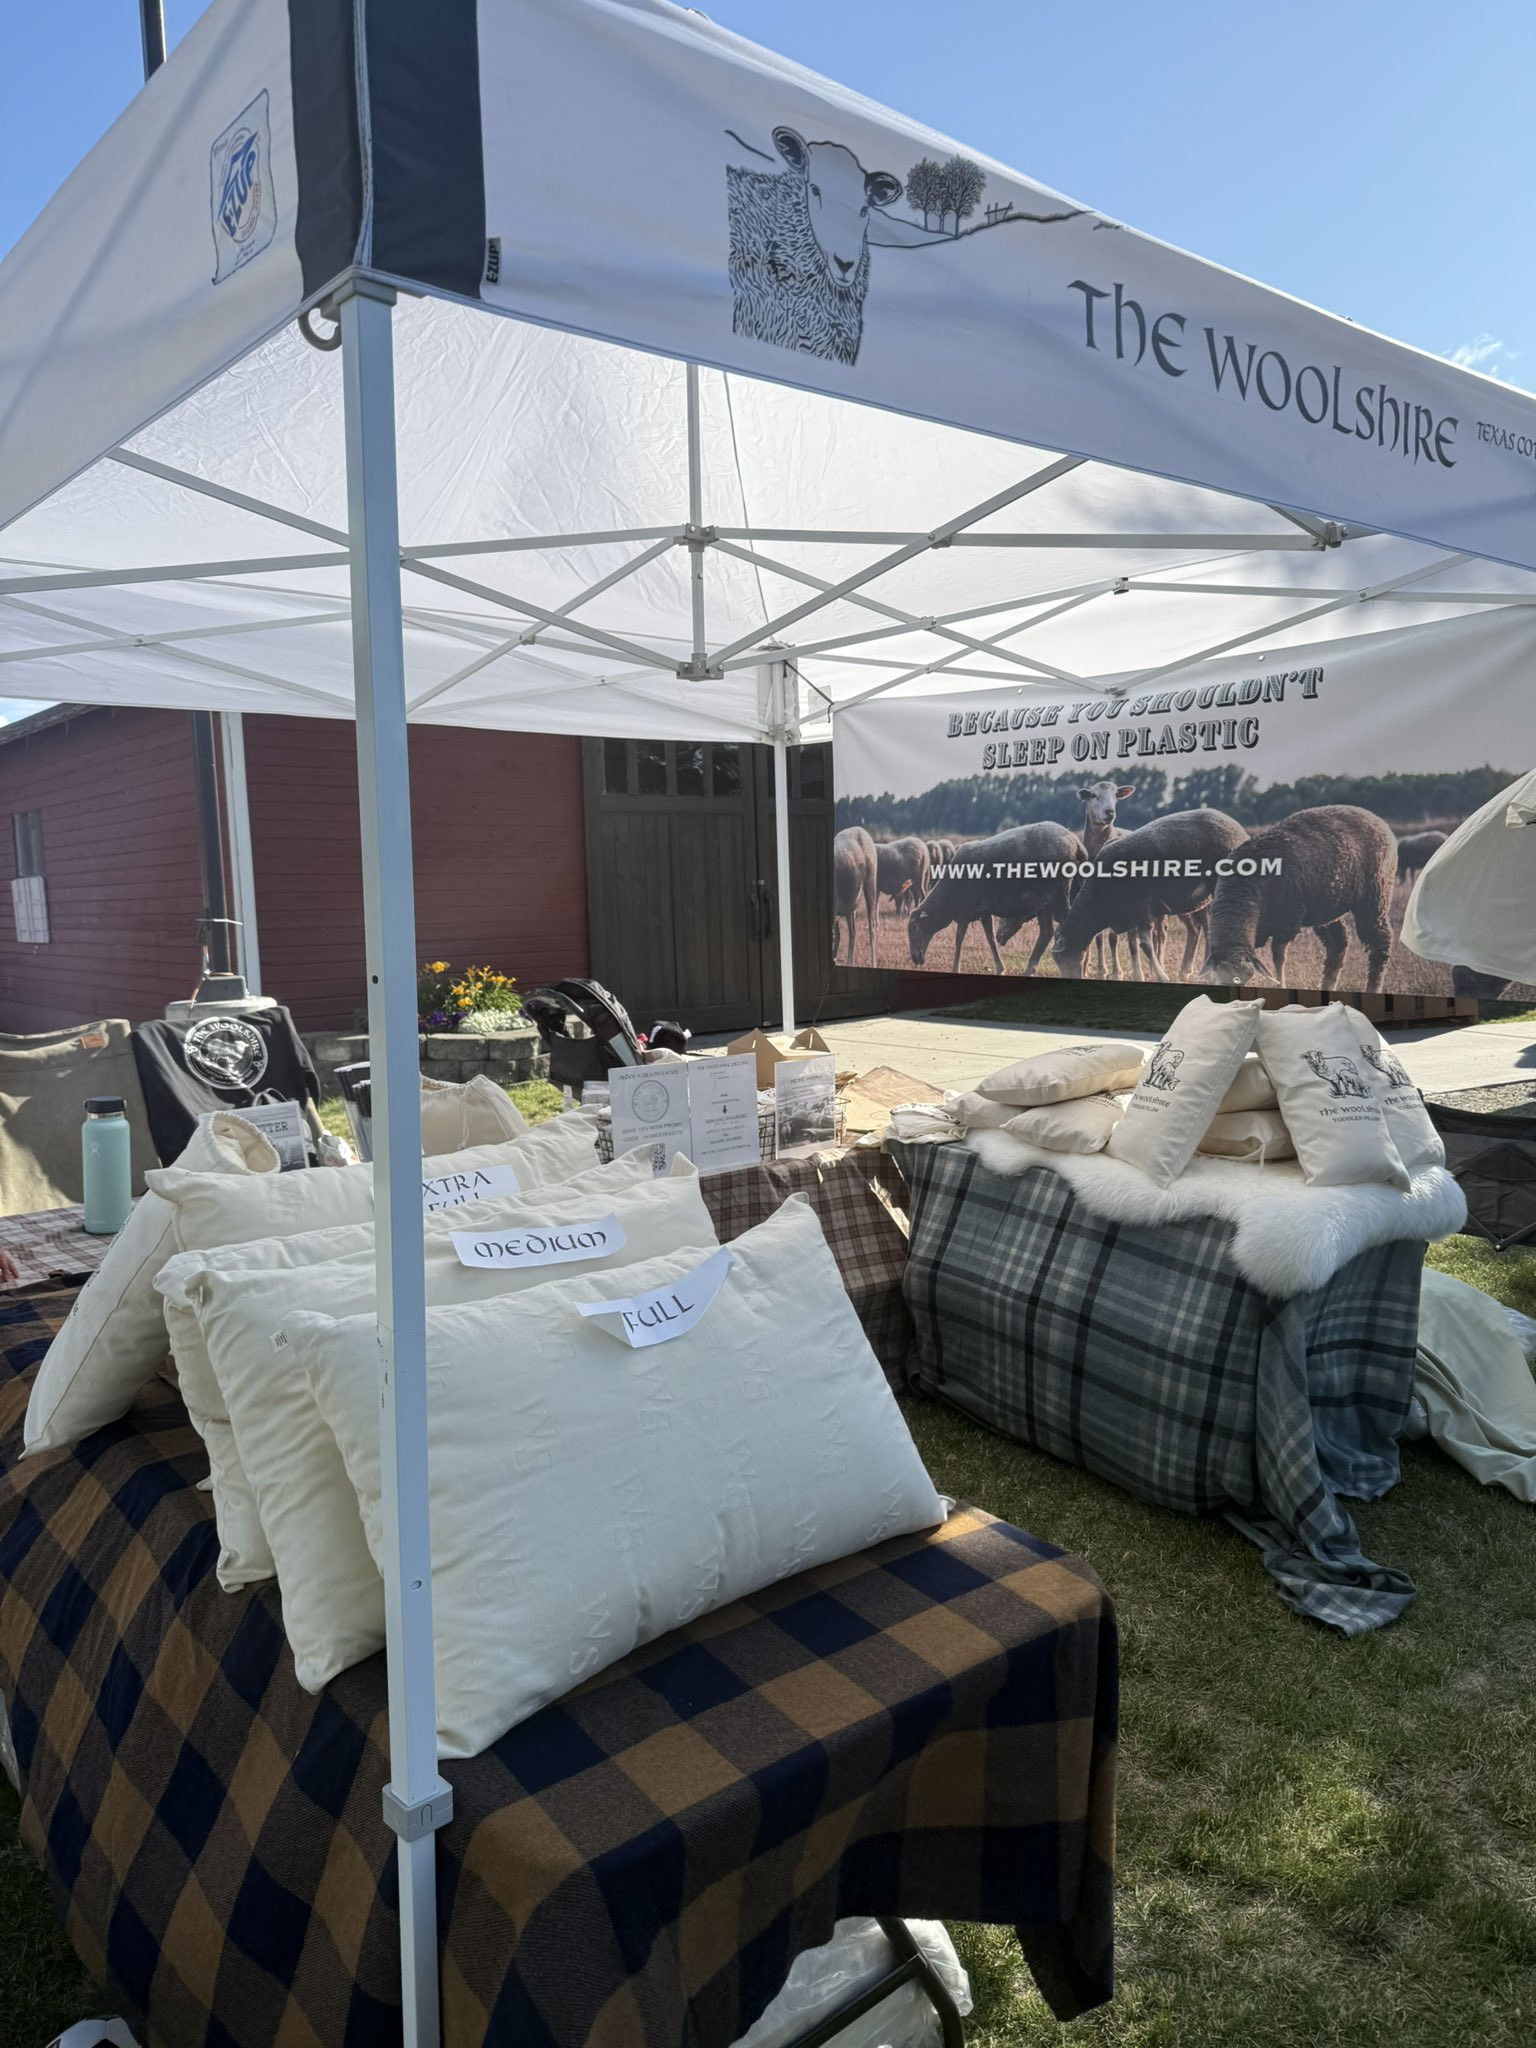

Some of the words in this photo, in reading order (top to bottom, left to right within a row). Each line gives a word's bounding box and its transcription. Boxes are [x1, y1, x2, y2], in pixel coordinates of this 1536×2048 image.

[1475, 421, 1515, 451] TEXAS
[946, 703, 1064, 737] BECAUSE
[1067, 698, 1130, 724] YOU
[1128, 667, 1324, 717] SHOULDN'T
[982, 735, 1065, 770] SLEEP
[1070, 730, 1109, 761] ON
[1116, 716, 1259, 758] PLASTIC
[930, 857, 1283, 880] WWW.THEWOOLSHIRE.COM
[421, 1171, 491, 1198] XTRA
[622, 1294, 696, 1334] FULL
